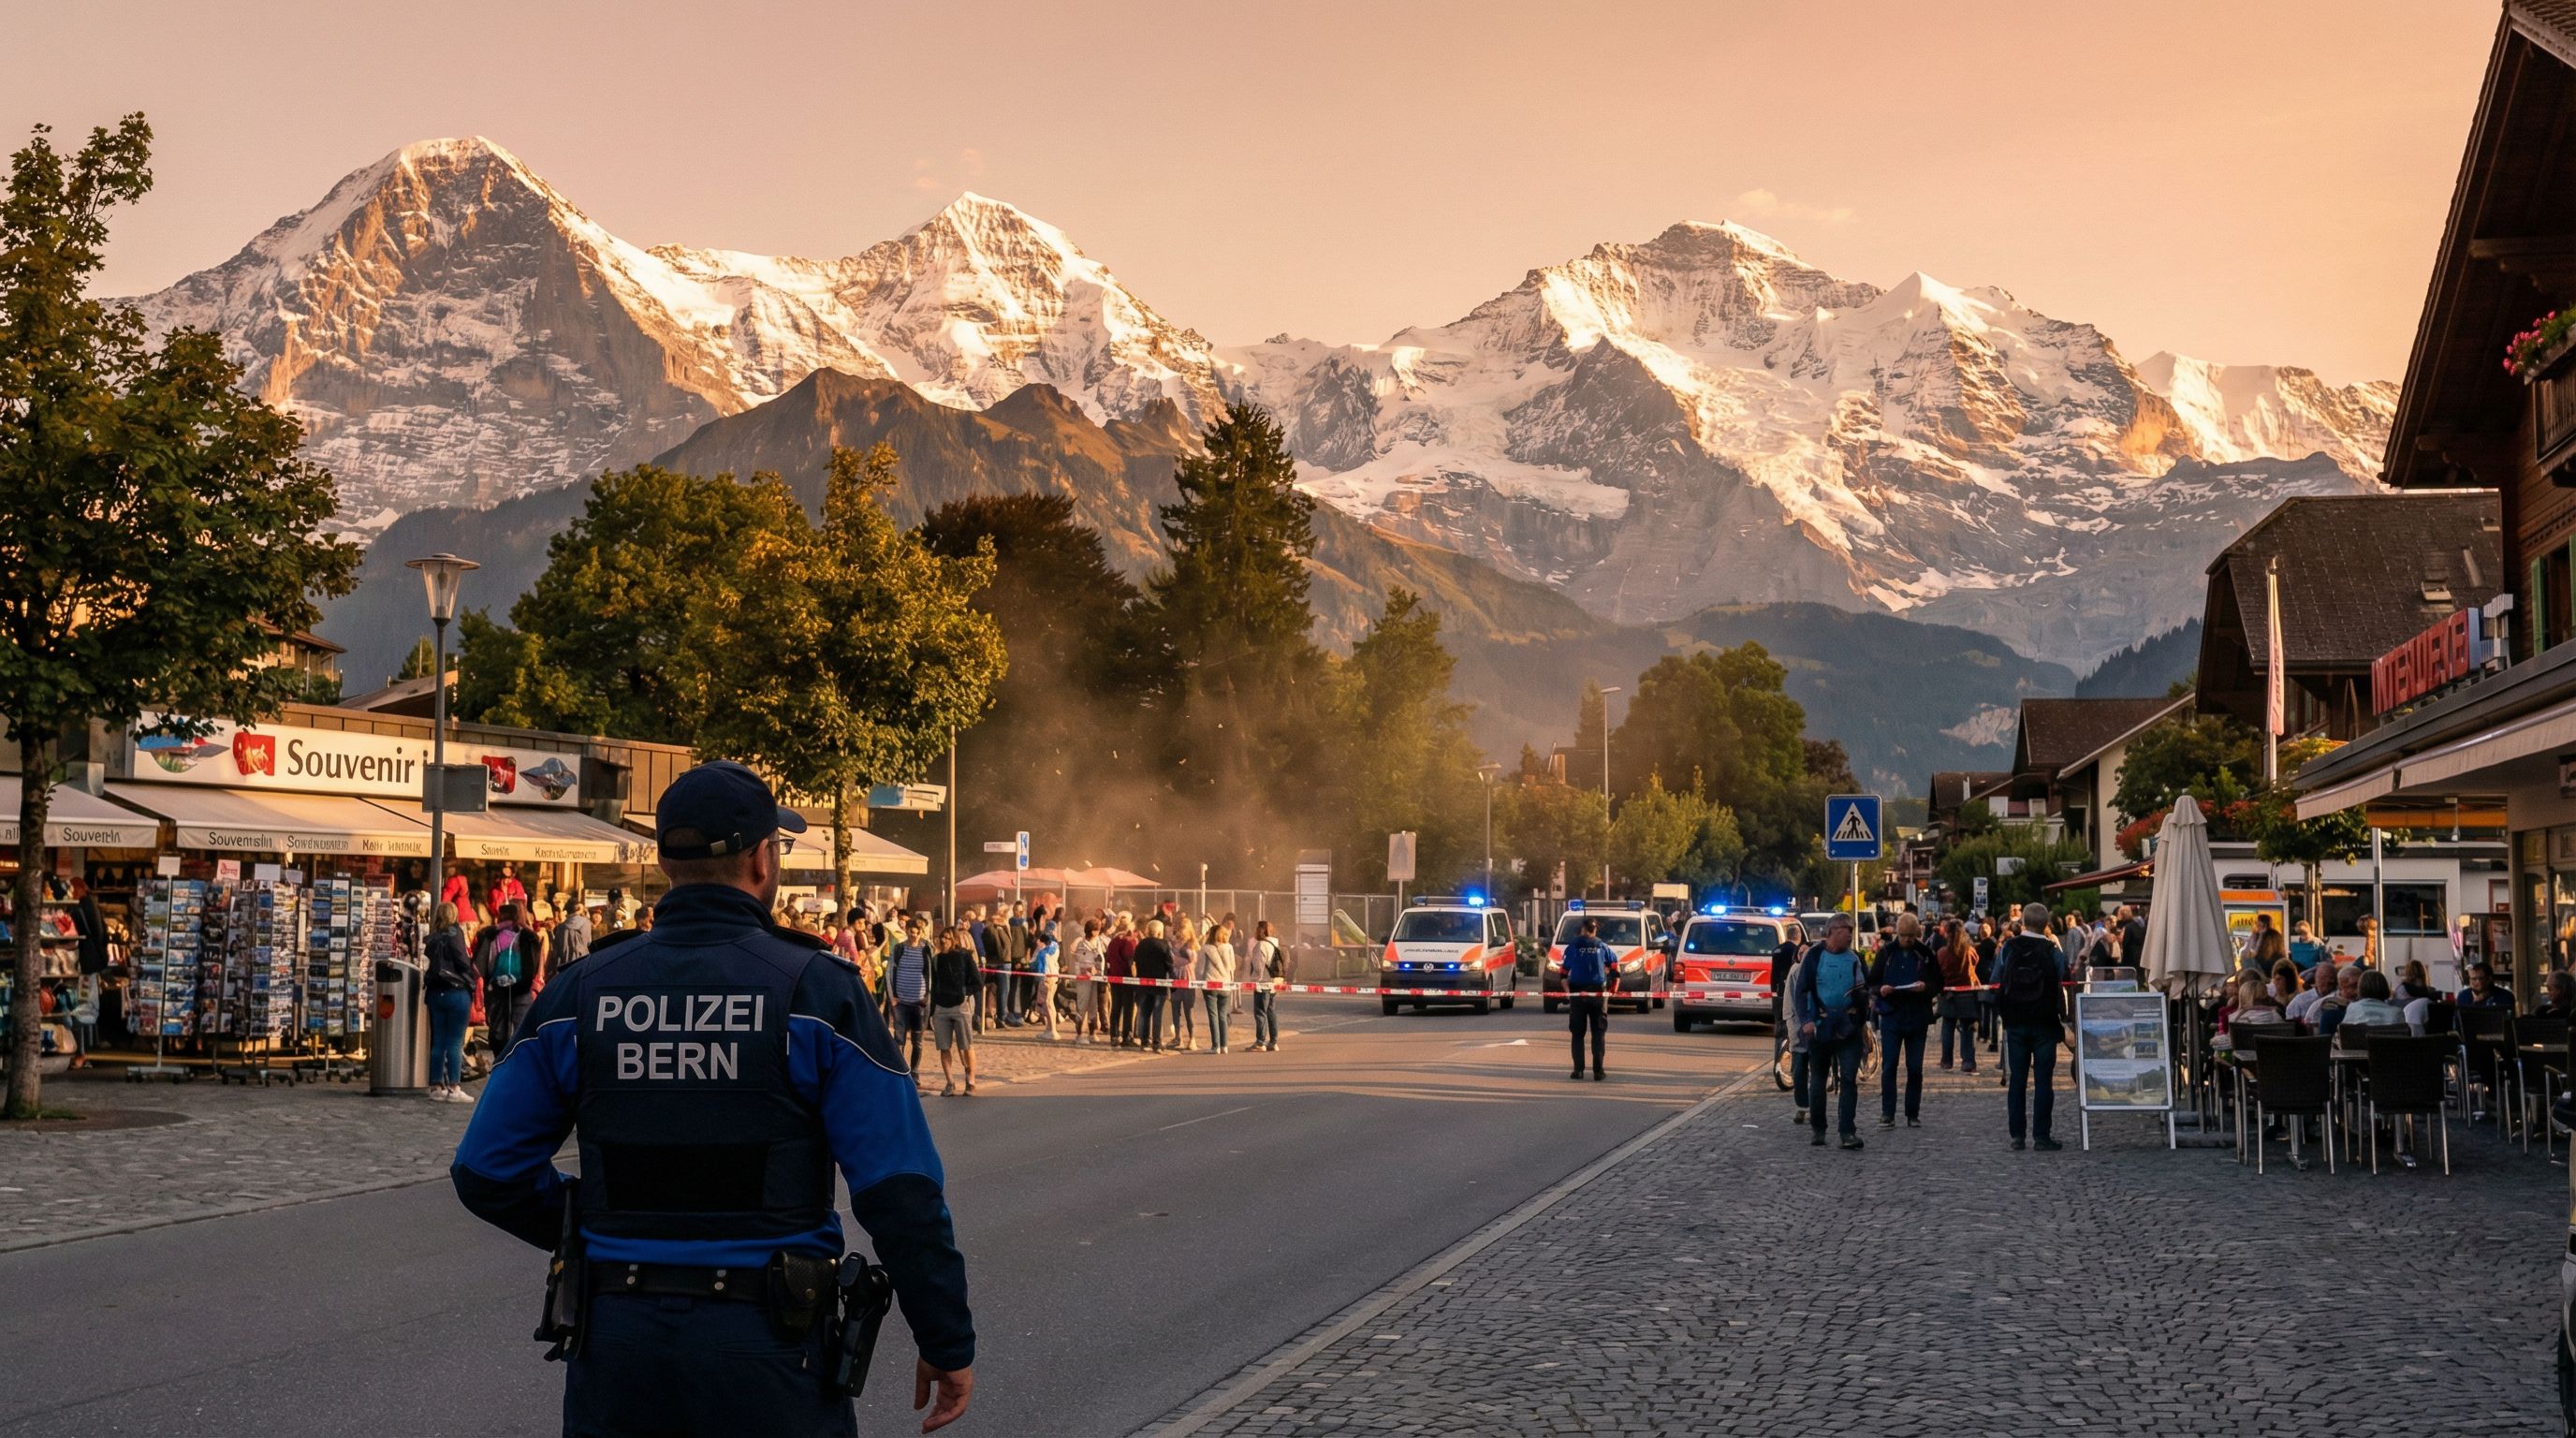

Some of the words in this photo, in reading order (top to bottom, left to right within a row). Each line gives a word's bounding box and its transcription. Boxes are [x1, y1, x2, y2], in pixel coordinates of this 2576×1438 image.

[287, 739, 415, 784] Souvenir
[596, 994, 765, 1033] POLIZEI
[617, 1042, 739, 1080] BERN
